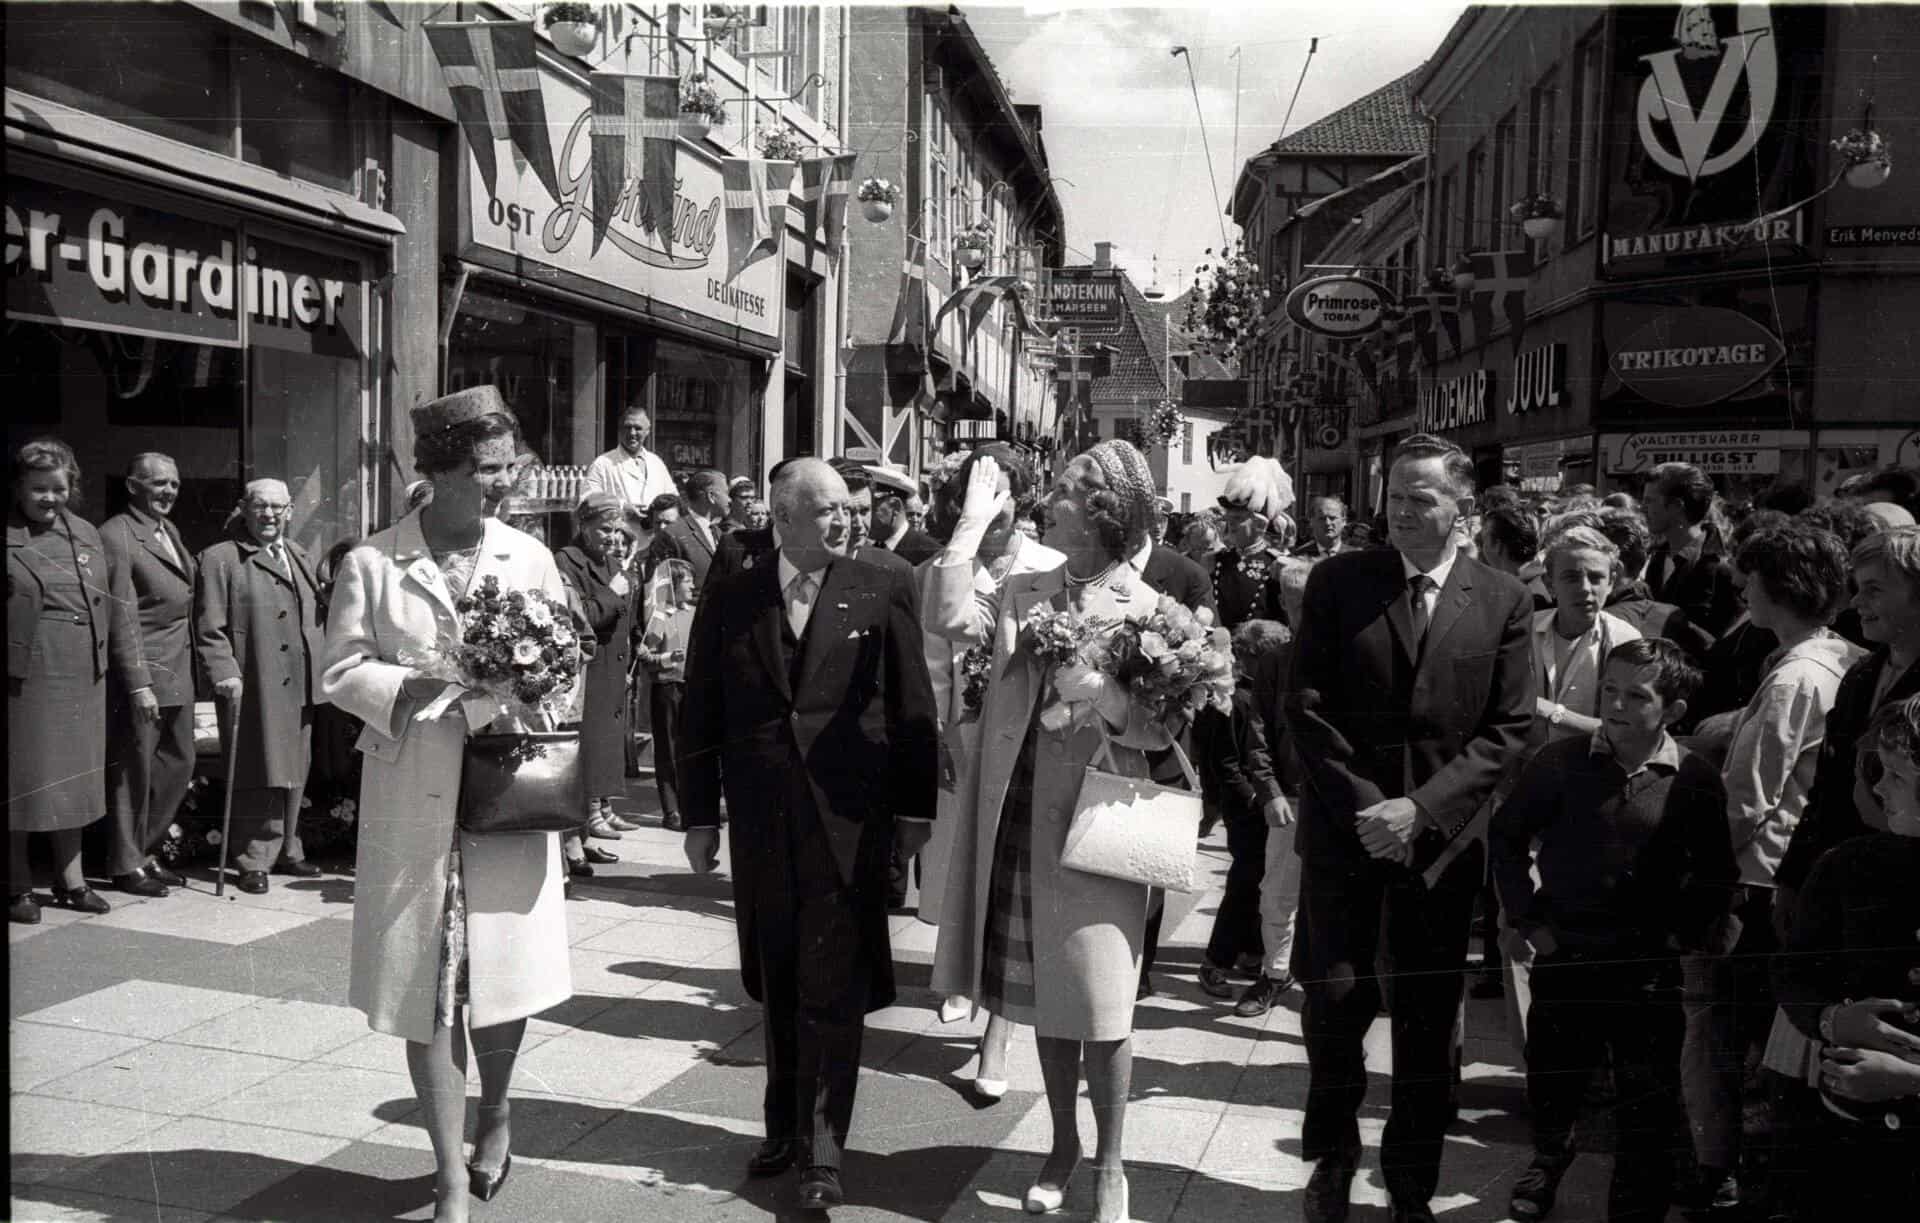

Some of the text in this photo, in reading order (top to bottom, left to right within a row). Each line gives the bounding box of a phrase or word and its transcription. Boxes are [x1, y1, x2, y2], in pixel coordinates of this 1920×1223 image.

[488, 197, 535, 236] OST
[1831, 228, 1857, 242] Erik
[1308, 292, 1380, 310] Primrose
[1322, 312, 1360, 321] TOBAK
[1618, 343, 1766, 371] TRIKOTAGE
[1421, 343, 1560, 433] VALDEMAR JUUL
[1630, 432, 1761, 449] KVALITETSVARER
[1653, 451, 1758, 465] BILLIGST
